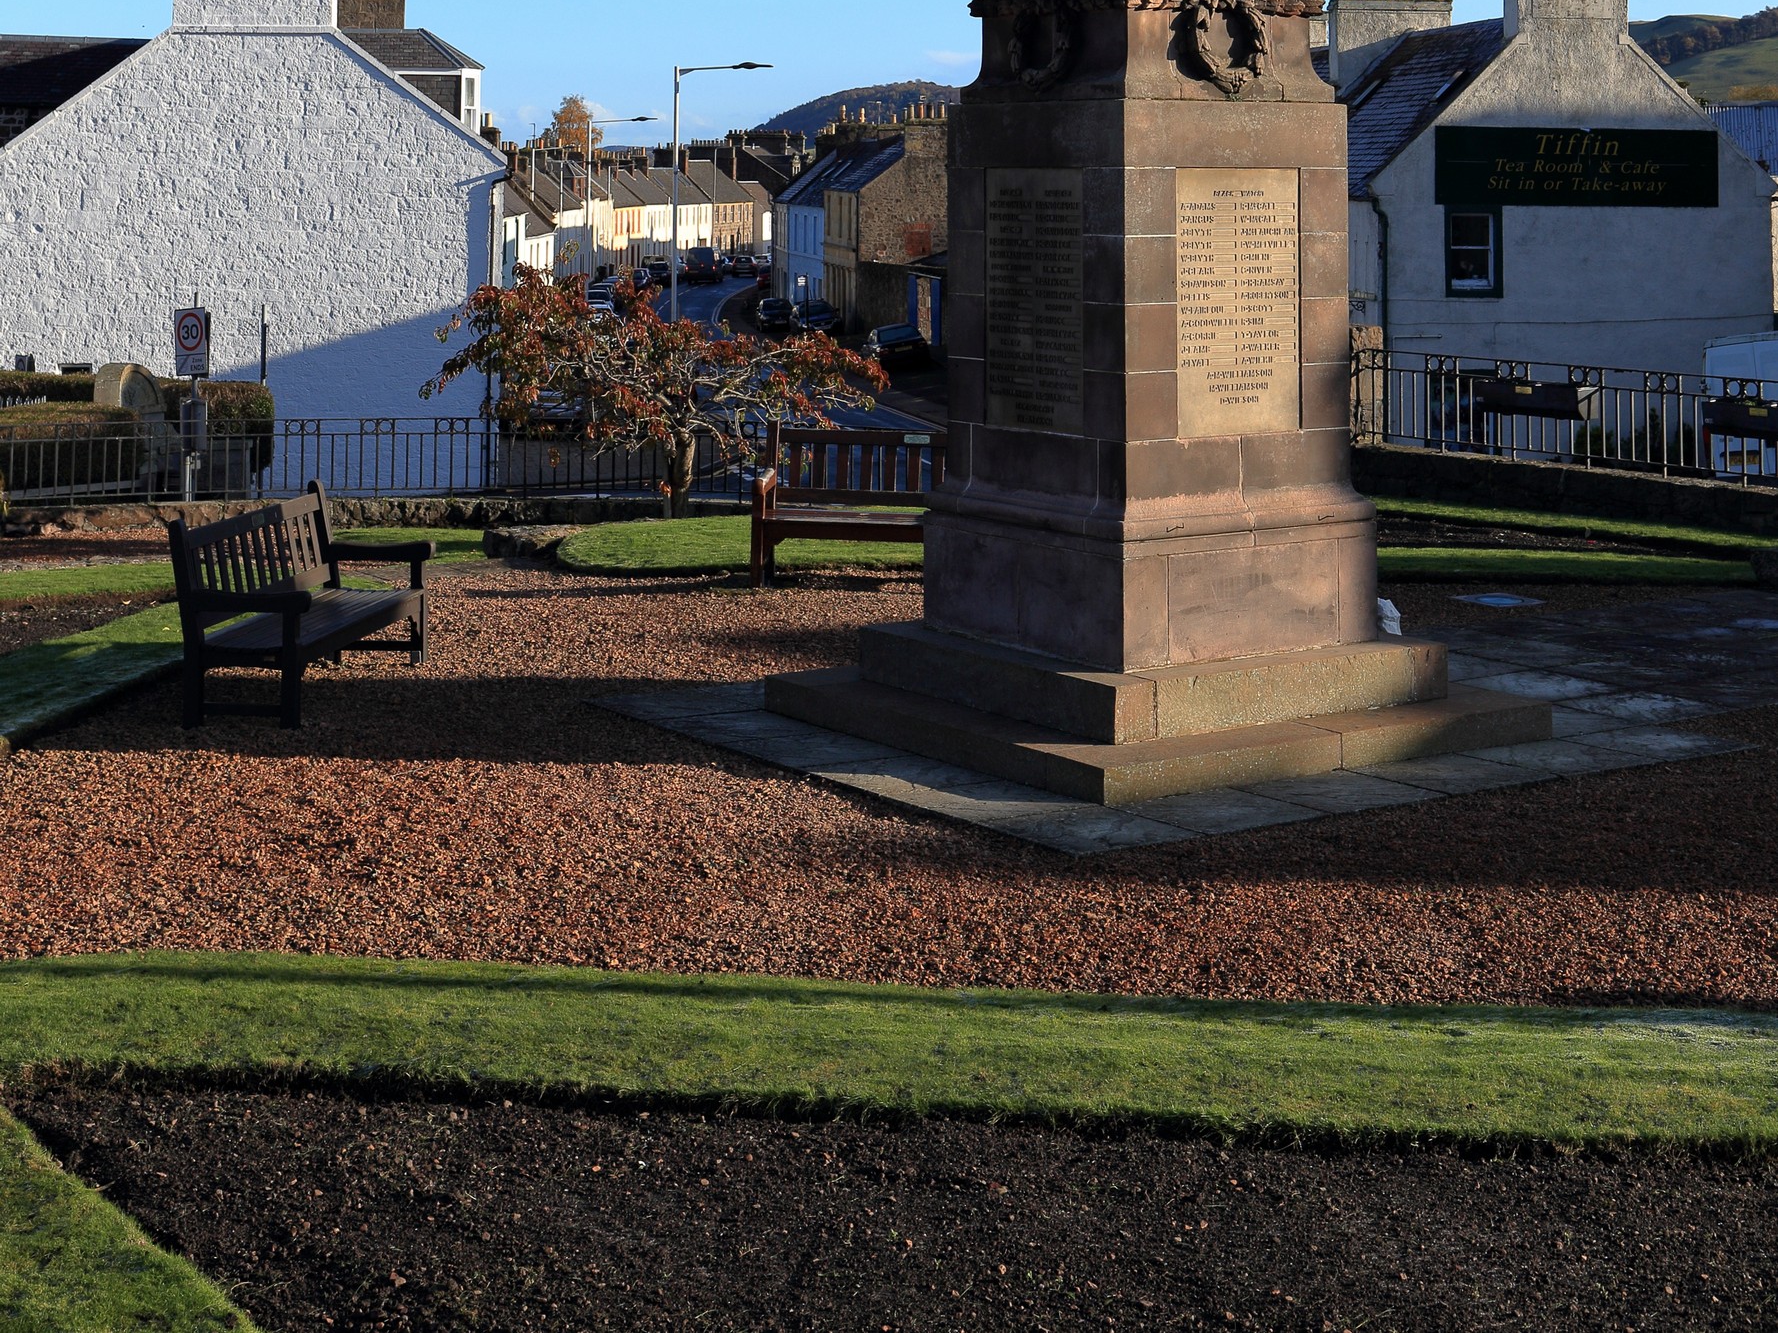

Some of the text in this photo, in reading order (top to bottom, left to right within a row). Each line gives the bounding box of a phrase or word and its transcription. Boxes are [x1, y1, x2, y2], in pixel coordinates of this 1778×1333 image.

[1536, 133, 1619, 156] Tiffin
[1495, 158, 1525, 173] Tea
[1534, 159, 1583, 173] Room
[1599, 161, 1611, 174] &
[1488, 176, 1667, 194] Sit in or Take-away
[182, 324, 199, 340] 30
